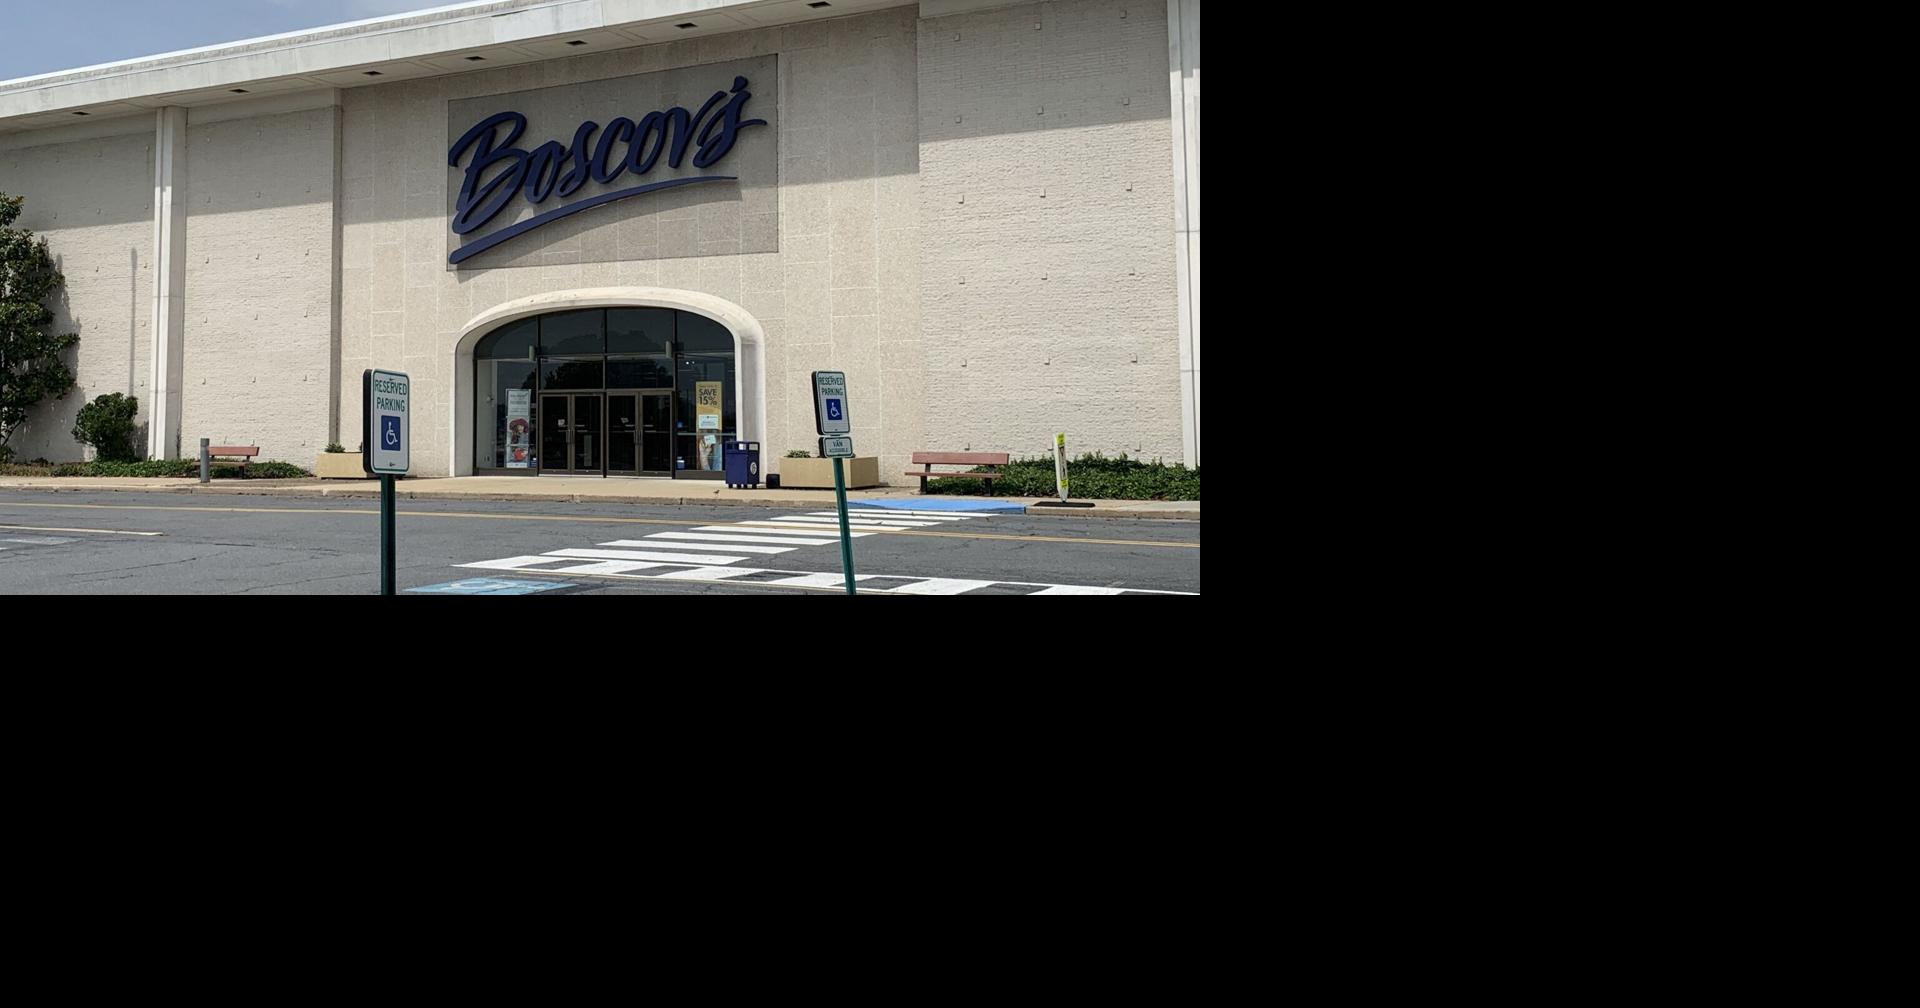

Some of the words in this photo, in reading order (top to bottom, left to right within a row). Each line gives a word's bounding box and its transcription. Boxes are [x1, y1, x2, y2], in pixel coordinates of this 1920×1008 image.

[818, 376, 843, 386] RESERVED
[374, 379, 407, 395] RESERVED
[698, 388, 717, 396] SAVE
[821, 387, 844, 396] PARKING
[376, 396, 405, 412] PARKING
[698, 396, 718, 406] 15%
